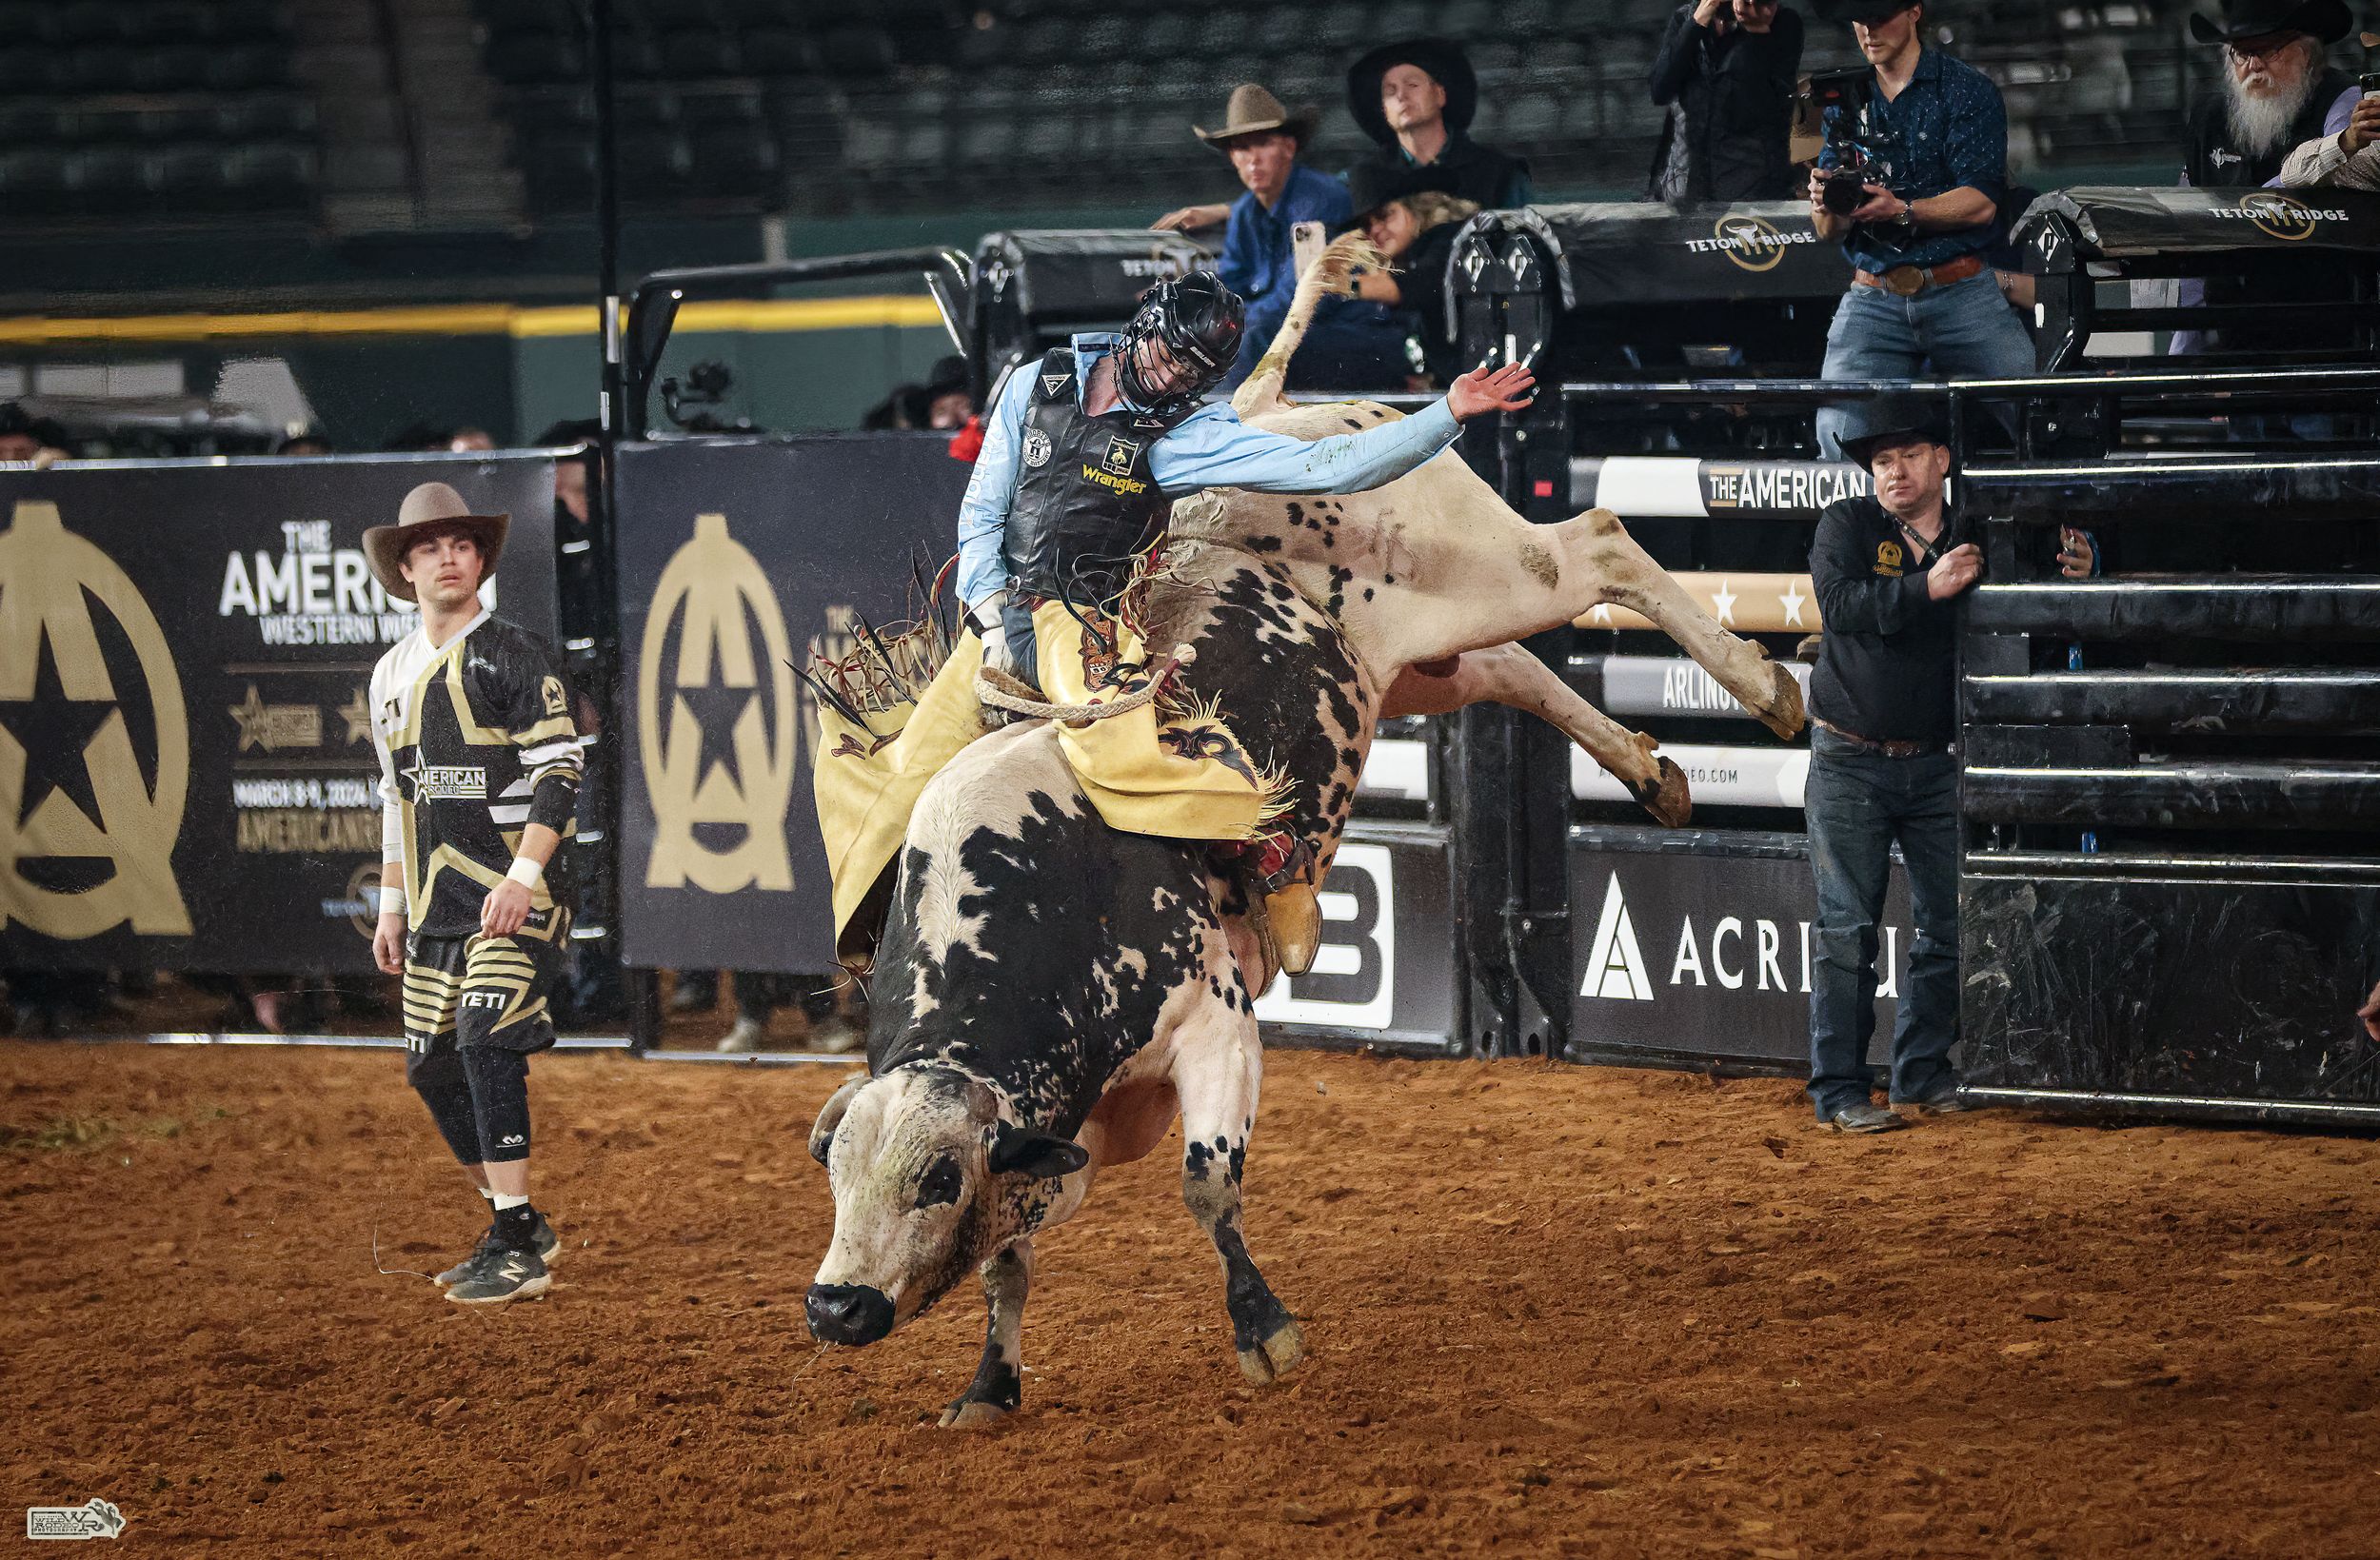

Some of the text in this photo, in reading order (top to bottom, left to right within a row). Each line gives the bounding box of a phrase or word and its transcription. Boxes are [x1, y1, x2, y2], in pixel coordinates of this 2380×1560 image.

[2209, 207, 2350, 221] TETON RIDGE
[1685, 231, 1816, 253] TETON RIDGE
[1082, 464, 1147, 496] Wrangler
[1709, 475, 1737, 502] THE
[1738, 468, 1867, 509] AMERICAN
[218, 548, 497, 616] AMERI
[258, 614, 375, 644] WESTERN
[419, 770, 486, 786] AMERICAN
[461, 981, 506, 1010] YETI
